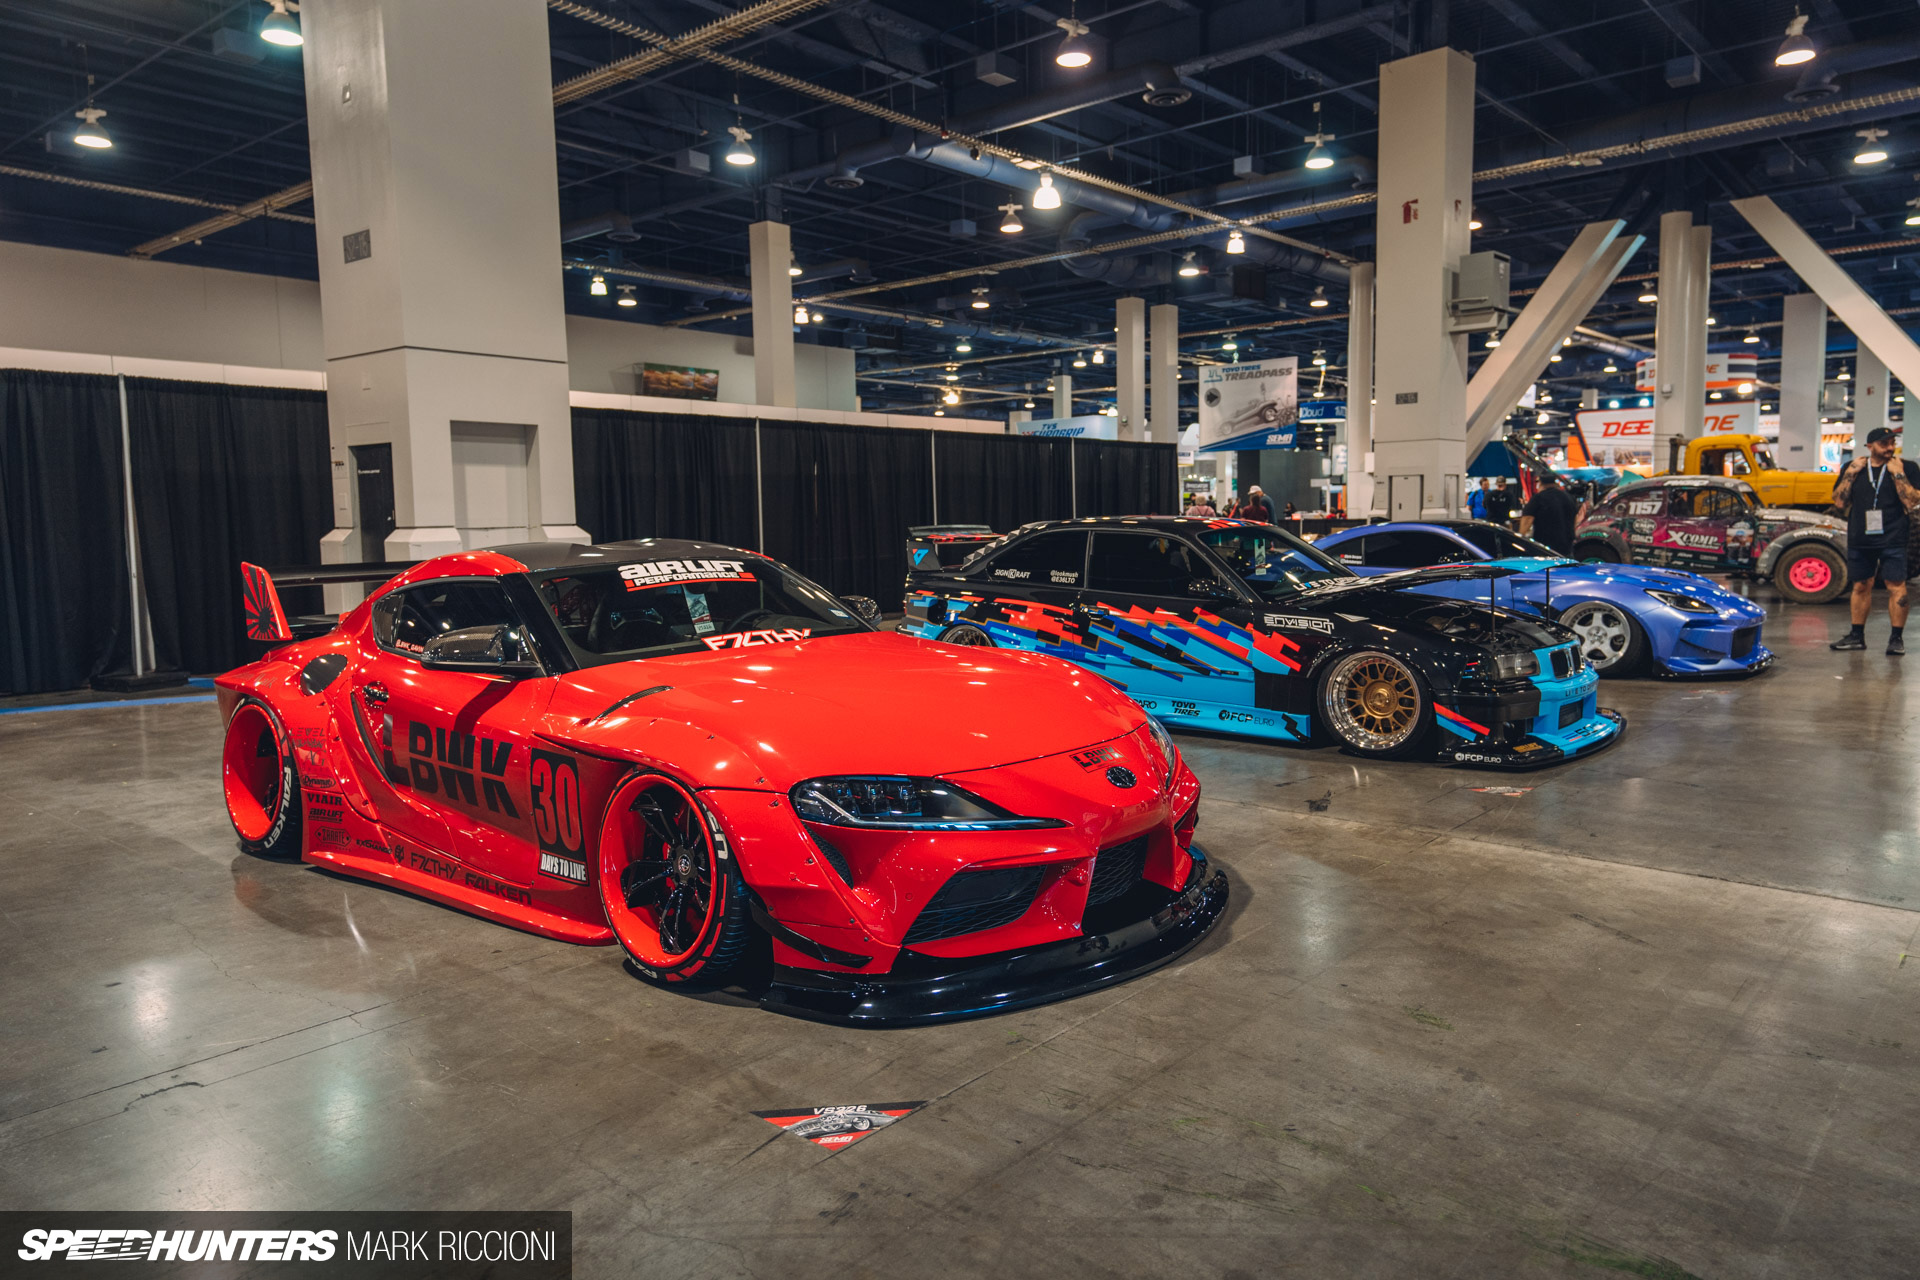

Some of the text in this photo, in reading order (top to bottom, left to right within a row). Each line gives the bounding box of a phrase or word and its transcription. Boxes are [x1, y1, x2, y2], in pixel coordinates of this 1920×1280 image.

[1225, 367, 1293, 382] TREADPASS
[1042, 422, 1058, 430] TVS
[1266, 433, 1293, 445] SEMA
[1629, 501, 1663, 515] 1157
[1171, 700, 1196, 709] TOYO
[1173, 708, 1201, 717] TIRES
[1230, 713, 1275, 727] FCP EURO
[1464, 752, 1502, 764] FCP EURO
[383, 713, 521, 820] LBWK
[307, 792, 343, 806] VIAIR
[532, 758, 582, 851] 30
[264, 766, 292, 849] FALKEN
[541, 853, 587, 881] DAYS TO LIVE
[465, 872, 532, 906] FALKEN
